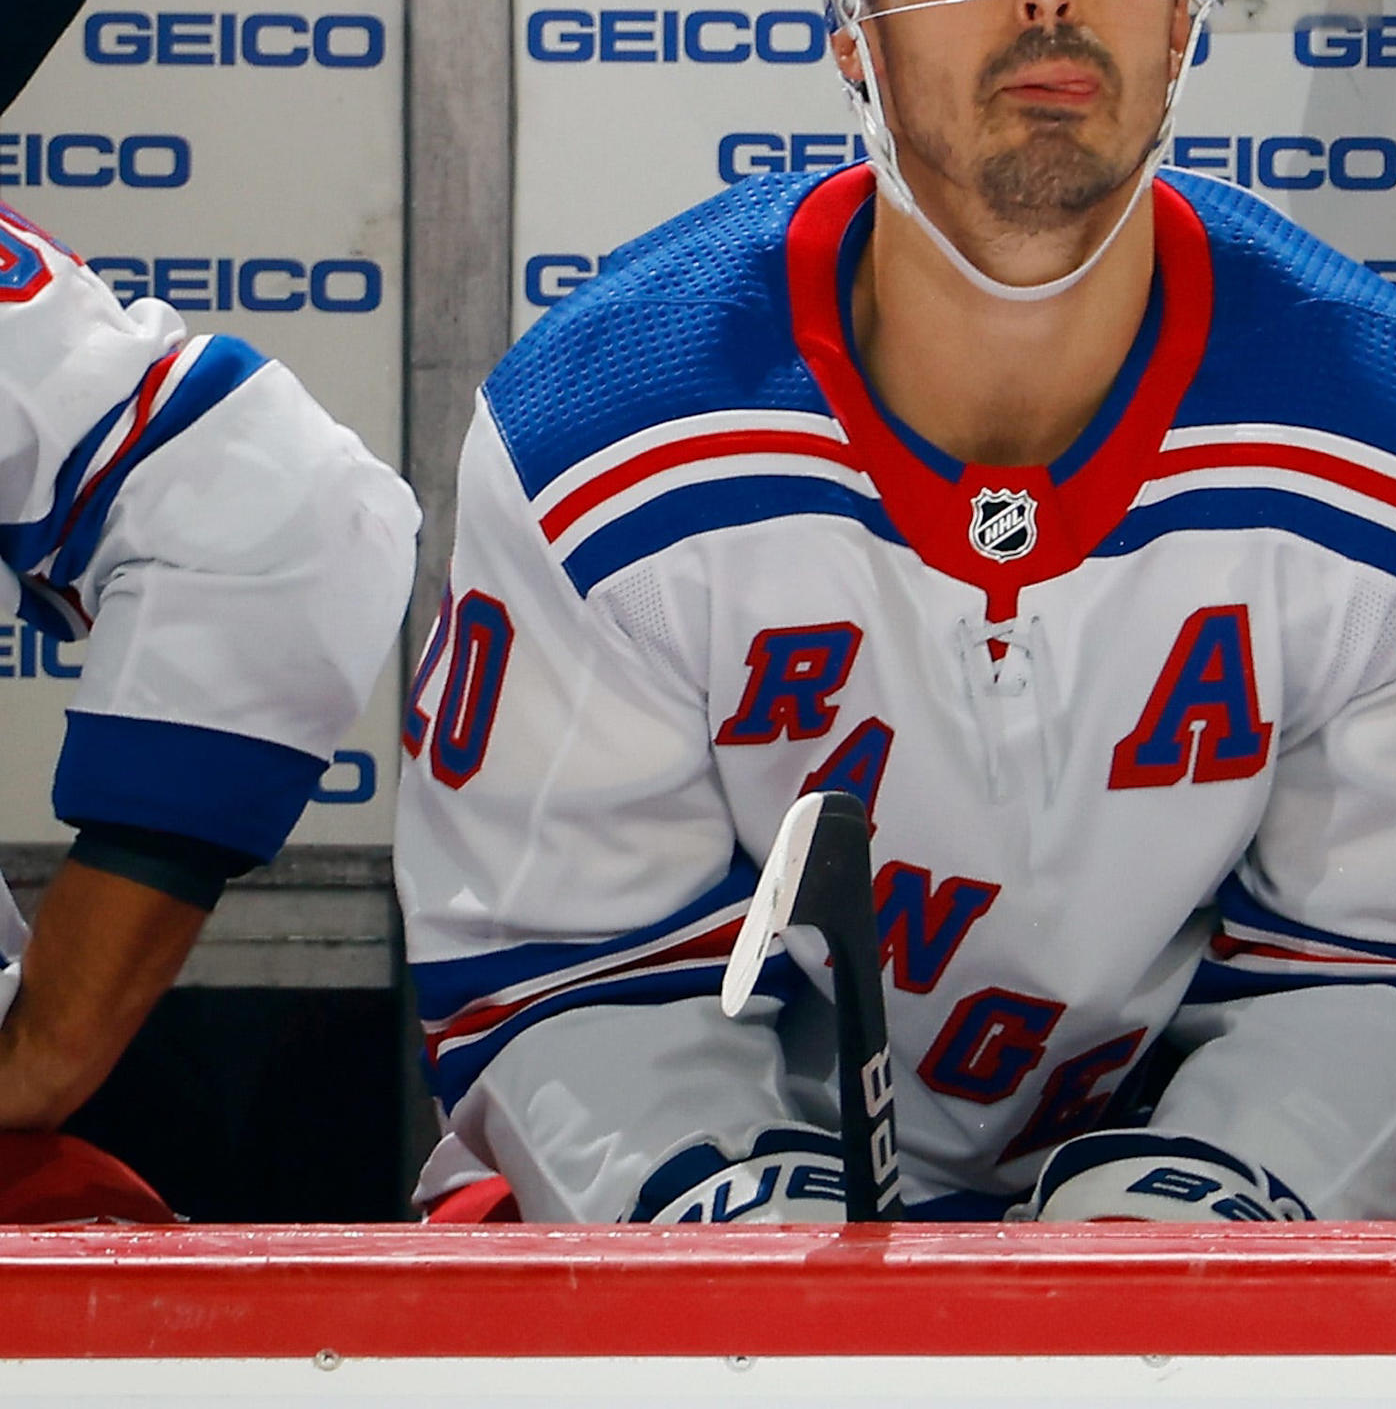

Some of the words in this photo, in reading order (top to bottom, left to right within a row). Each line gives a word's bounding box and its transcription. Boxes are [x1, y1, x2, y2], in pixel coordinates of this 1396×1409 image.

[83, 12, 386, 68] GEICO
[527, 9, 824, 64] GEICO
[984, 507, 1024, 545] NHL
[1108, 603, 1273, 791] A
